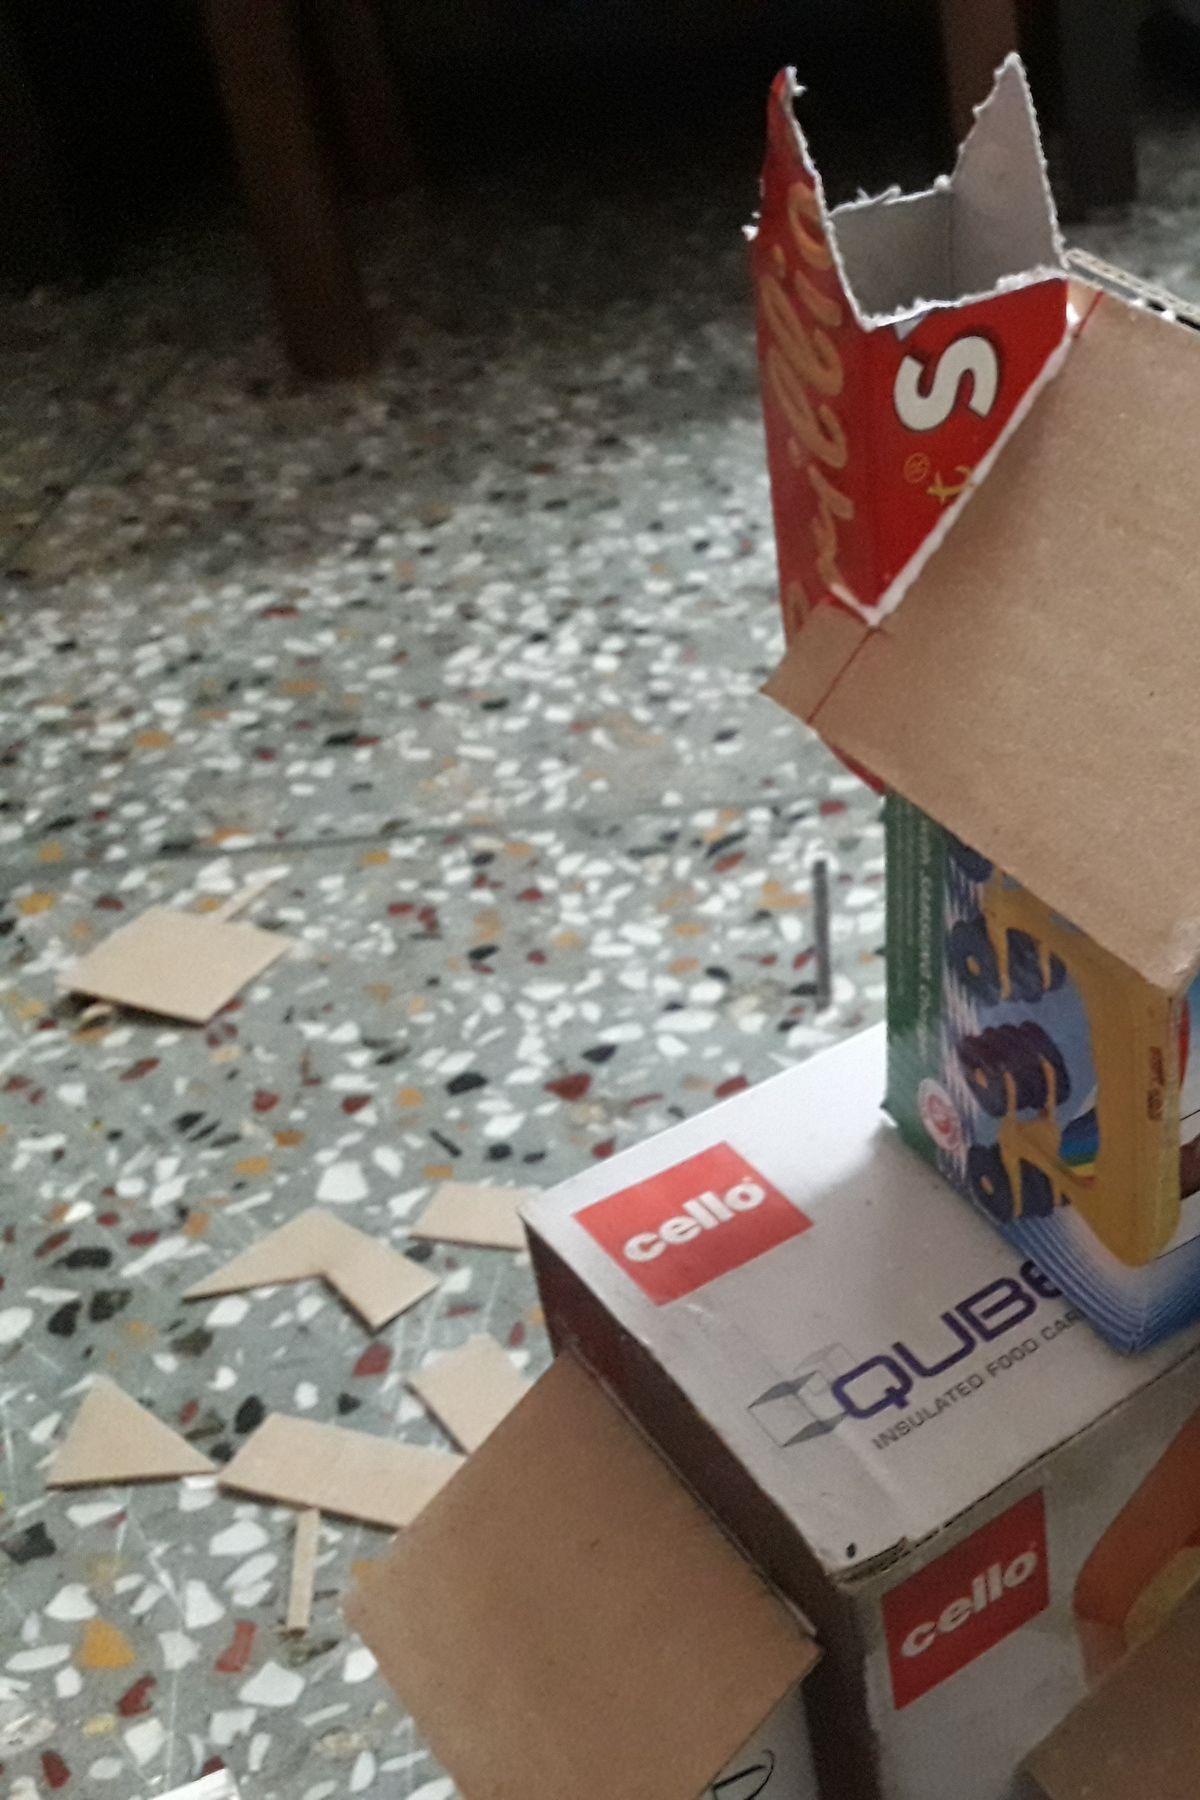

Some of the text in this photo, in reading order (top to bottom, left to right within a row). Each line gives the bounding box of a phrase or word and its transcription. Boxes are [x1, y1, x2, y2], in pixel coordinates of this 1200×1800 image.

[623, 1181, 767, 1263] cello
[872, 1372, 986, 1450] INSULATED
[984, 1336, 1040, 1379] FOOD
[901, 1551, 1039, 1659] cello
